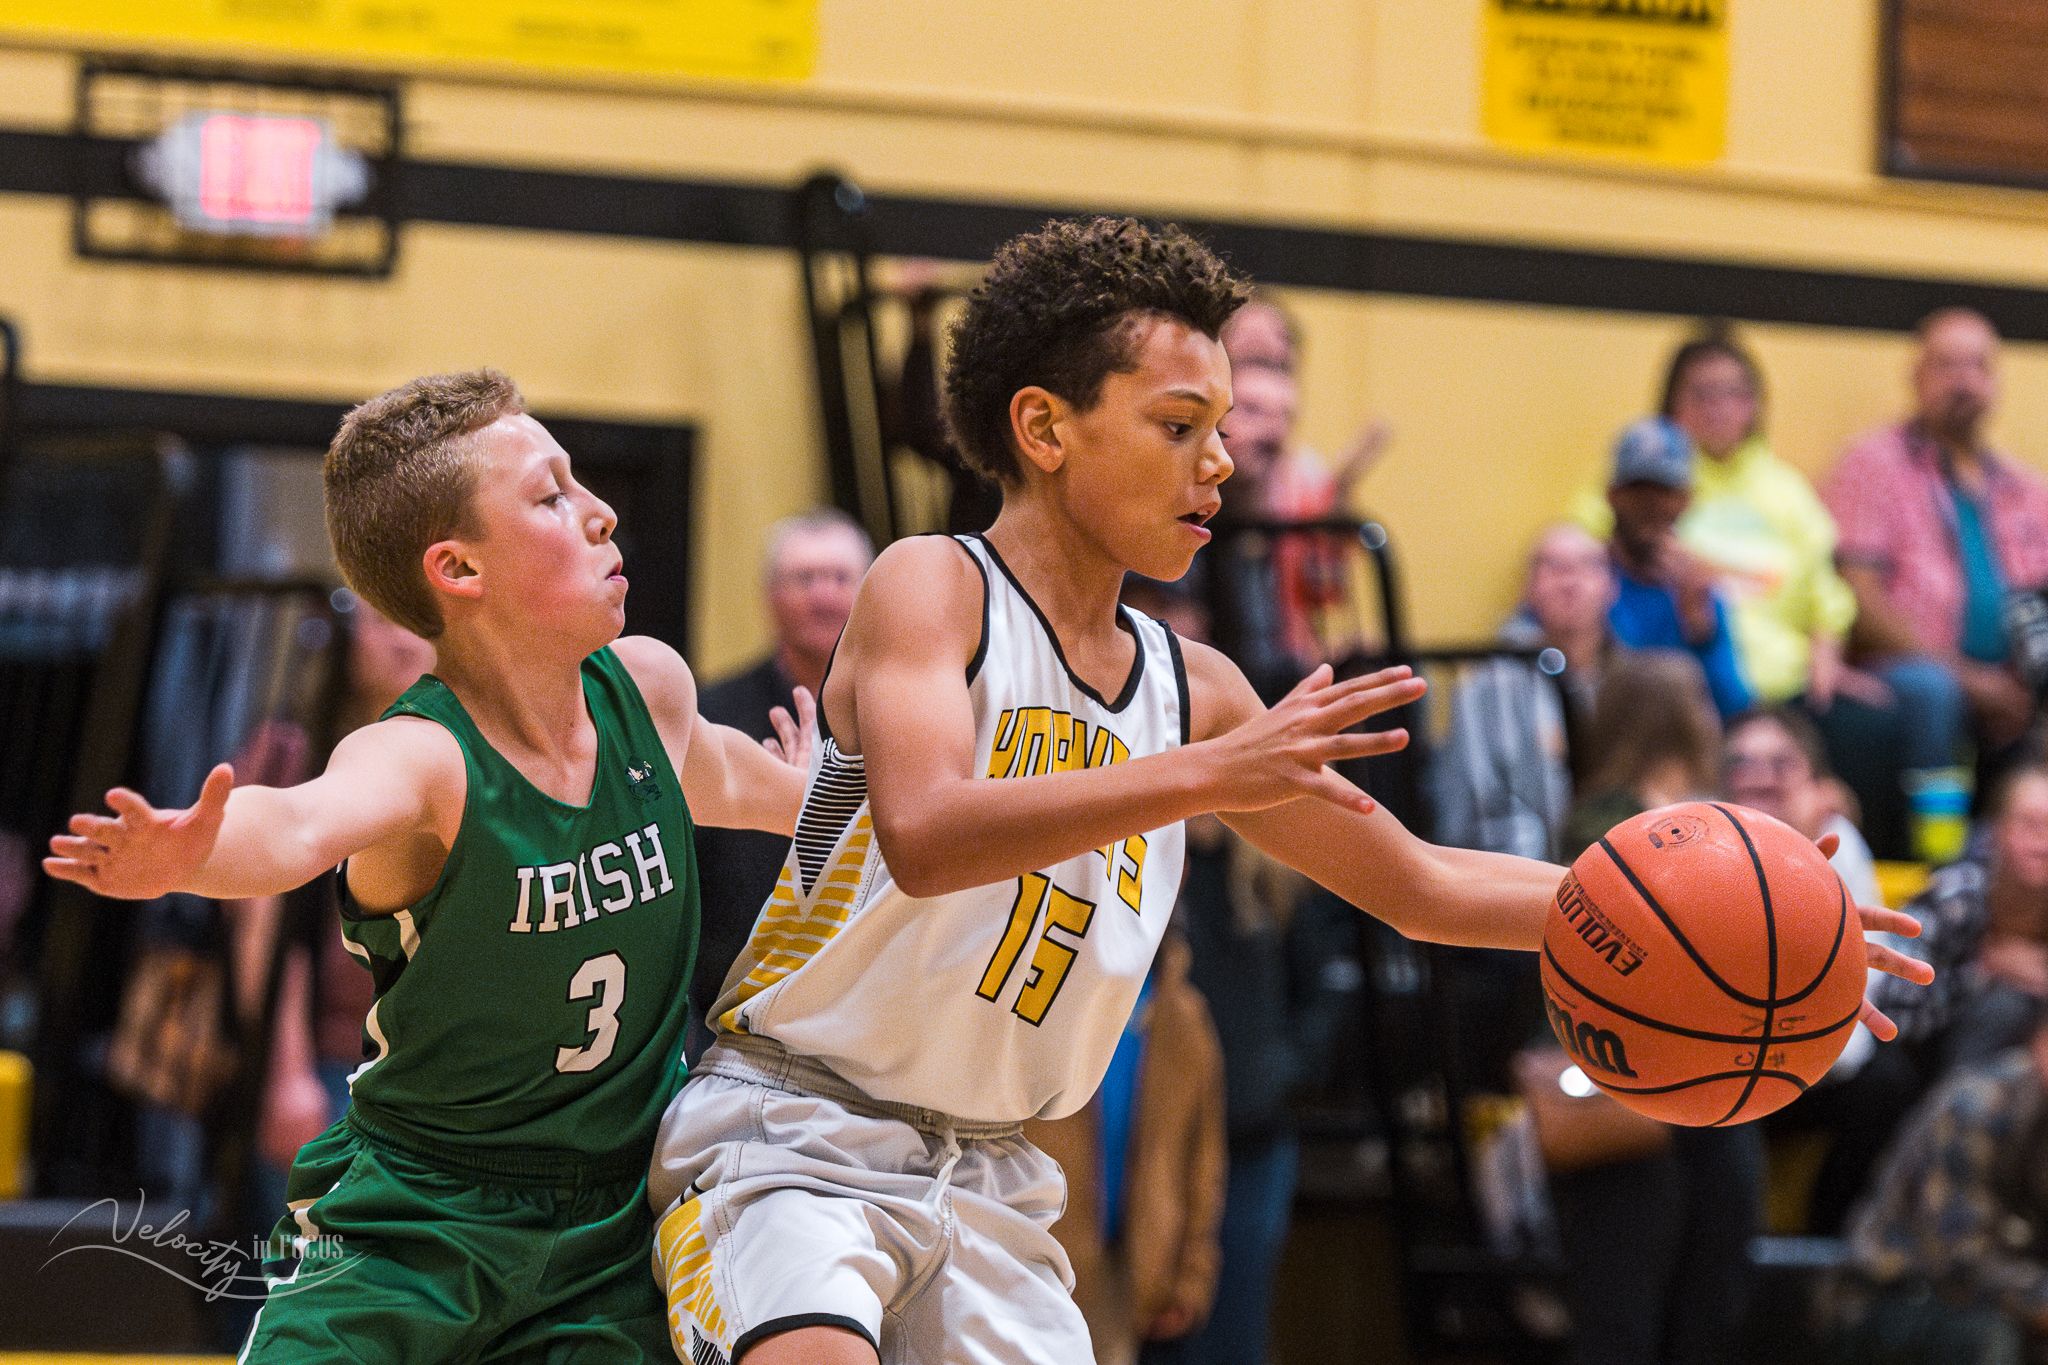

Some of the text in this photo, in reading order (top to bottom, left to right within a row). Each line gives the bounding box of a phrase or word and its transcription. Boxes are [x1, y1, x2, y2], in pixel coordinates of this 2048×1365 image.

[507, 822, 674, 933] IRISH
[1556, 880, 1643, 976] EVOLUTI
[975, 872, 1097, 1027] 15
[555, 949, 628, 1074] 3
